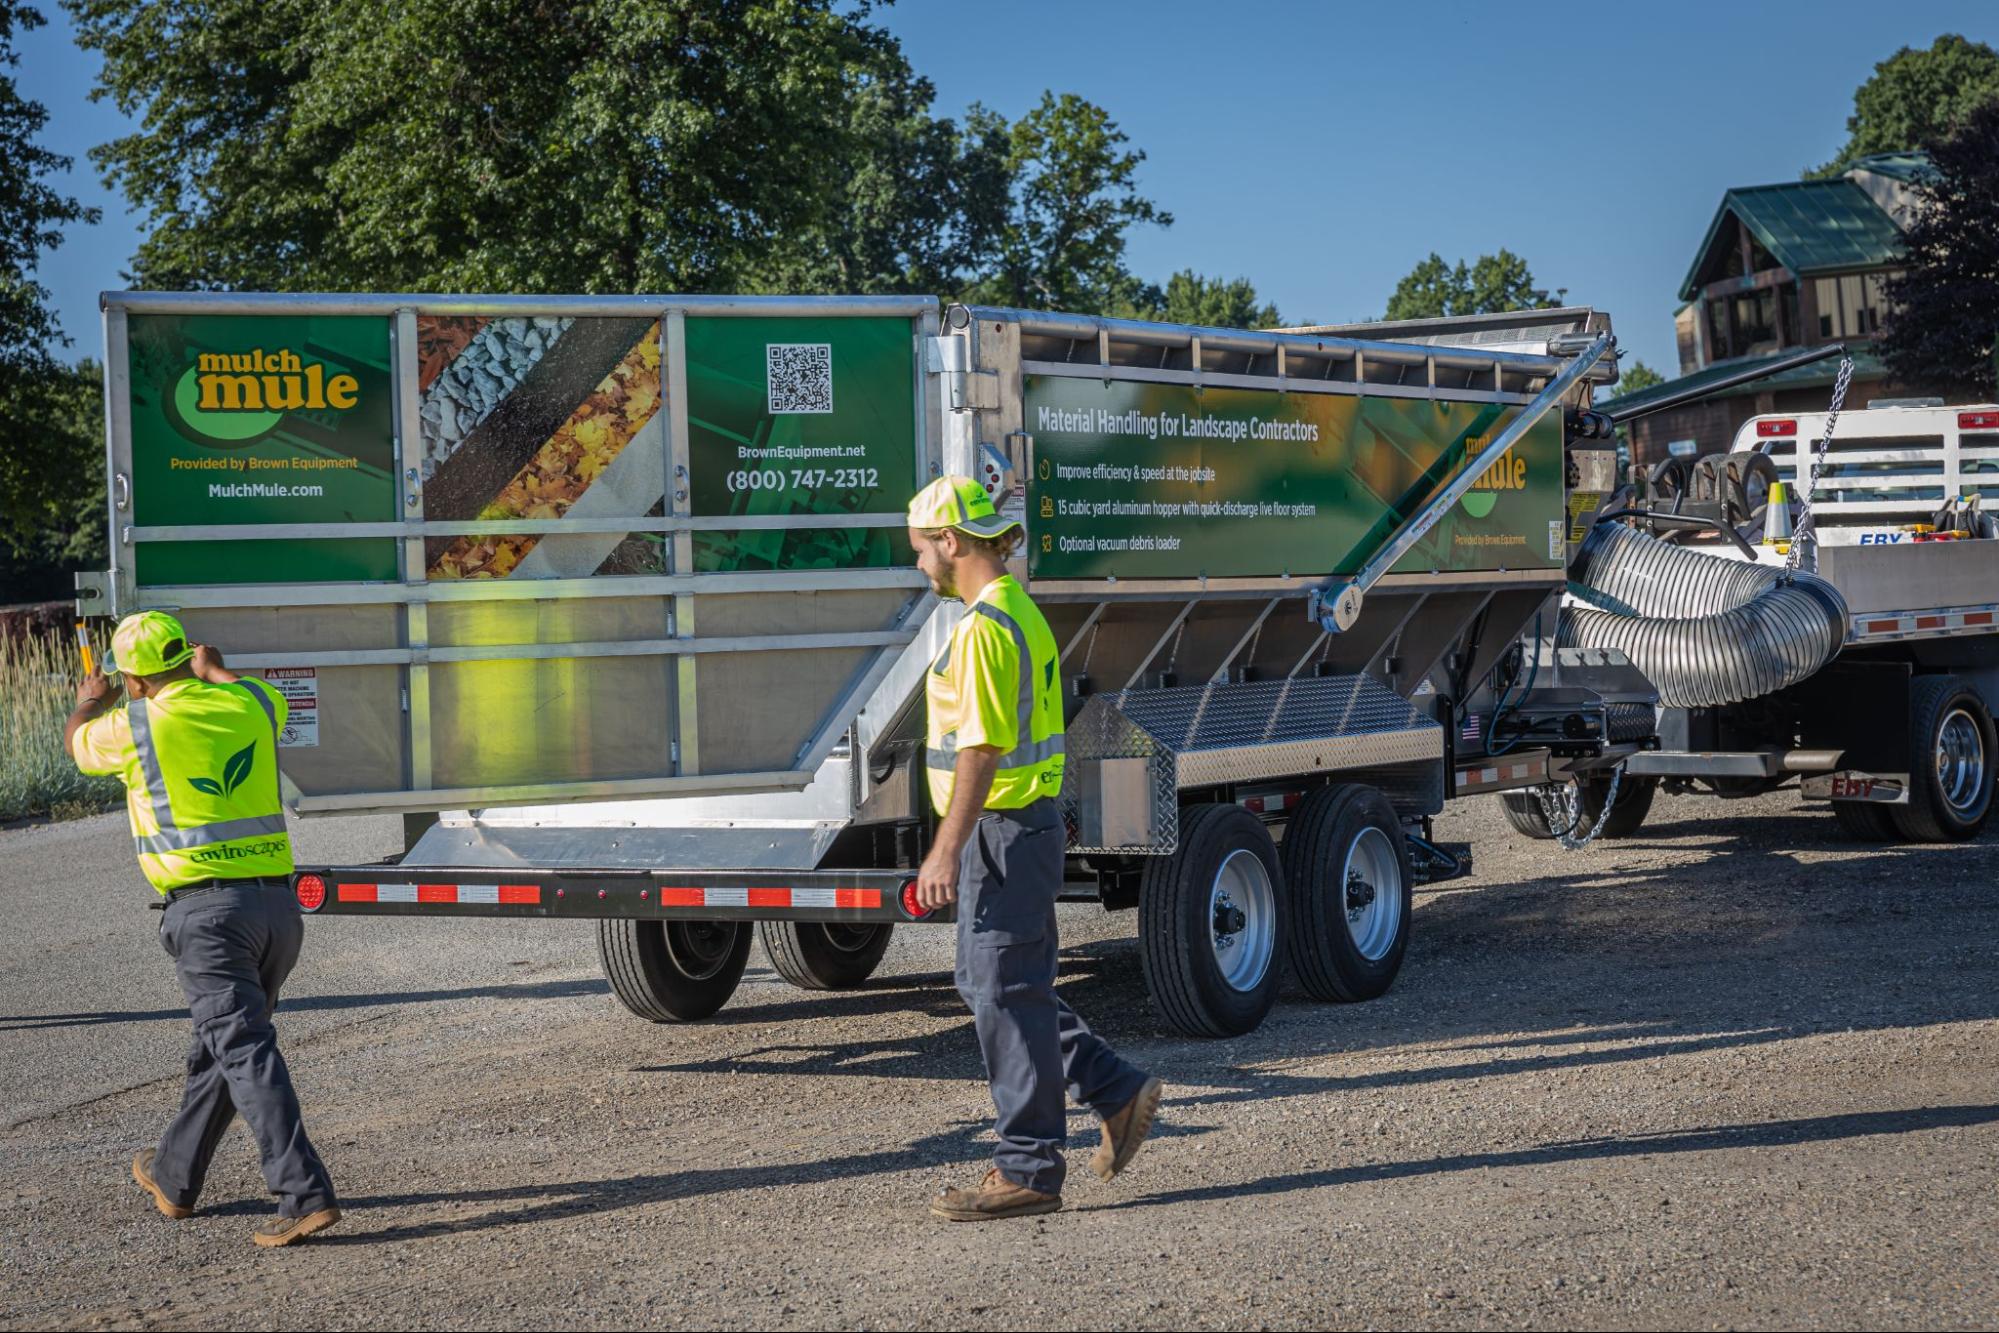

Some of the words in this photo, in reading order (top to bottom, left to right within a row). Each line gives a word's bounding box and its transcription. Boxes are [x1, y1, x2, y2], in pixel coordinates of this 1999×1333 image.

[199, 349, 302, 373] mulch
[199, 364, 359, 410] mule
[1038, 406, 1095, 433] Material
[1097, 409, 1158, 440] Handling
[1160, 411, 1180, 436] for
[1182, 413, 1248, 443] Landscape
[1250, 416, 1319, 442] Contractors
[738, 444, 866, 460] BrownEquipment.net
[170, 456, 227, 470] Provided
[230, 457, 245, 472] by
[249, 457, 289, 469] Brown
[292, 456, 358, 471] Equipment
[1056, 463, 1091, 481] Improve
[1092, 463, 1132, 482] efficiency
[1133, 464, 1140, 480] &
[1141, 465, 1165, 482] speed
[1166, 466, 1175, 480] at
[1175, 466, 1189, 481] the
[1189, 466, 1216, 483] jobsite
[726, 470, 786, 493] (800)
[791, 468, 879, 490] 747-2312
[208, 483, 323, 498] MulchMule.com
[1058, 499, 1067, 515] 15
[1068, 499, 1091, 516] cubic
[1092, 499, 1111, 518] yard
[1112, 499, 1152, 516] aluminum
[1153, 500, 1181, 518] hopper
[1182, 501, 1200, 516] with
[1200, 501, 1259, 518] quick-discharge
[1259, 501, 1273, 516] live
[1273, 501, 1290, 516] floor
[1291, 502, 1316, 518] system
[1059, 535, 1096, 554] Optional
[1096, 538, 1126, 552] vacuum
[1128, 535, 1154, 551] debris
[1155, 535, 1181, 551] loader
[278, 670, 314, 678] WARNING
